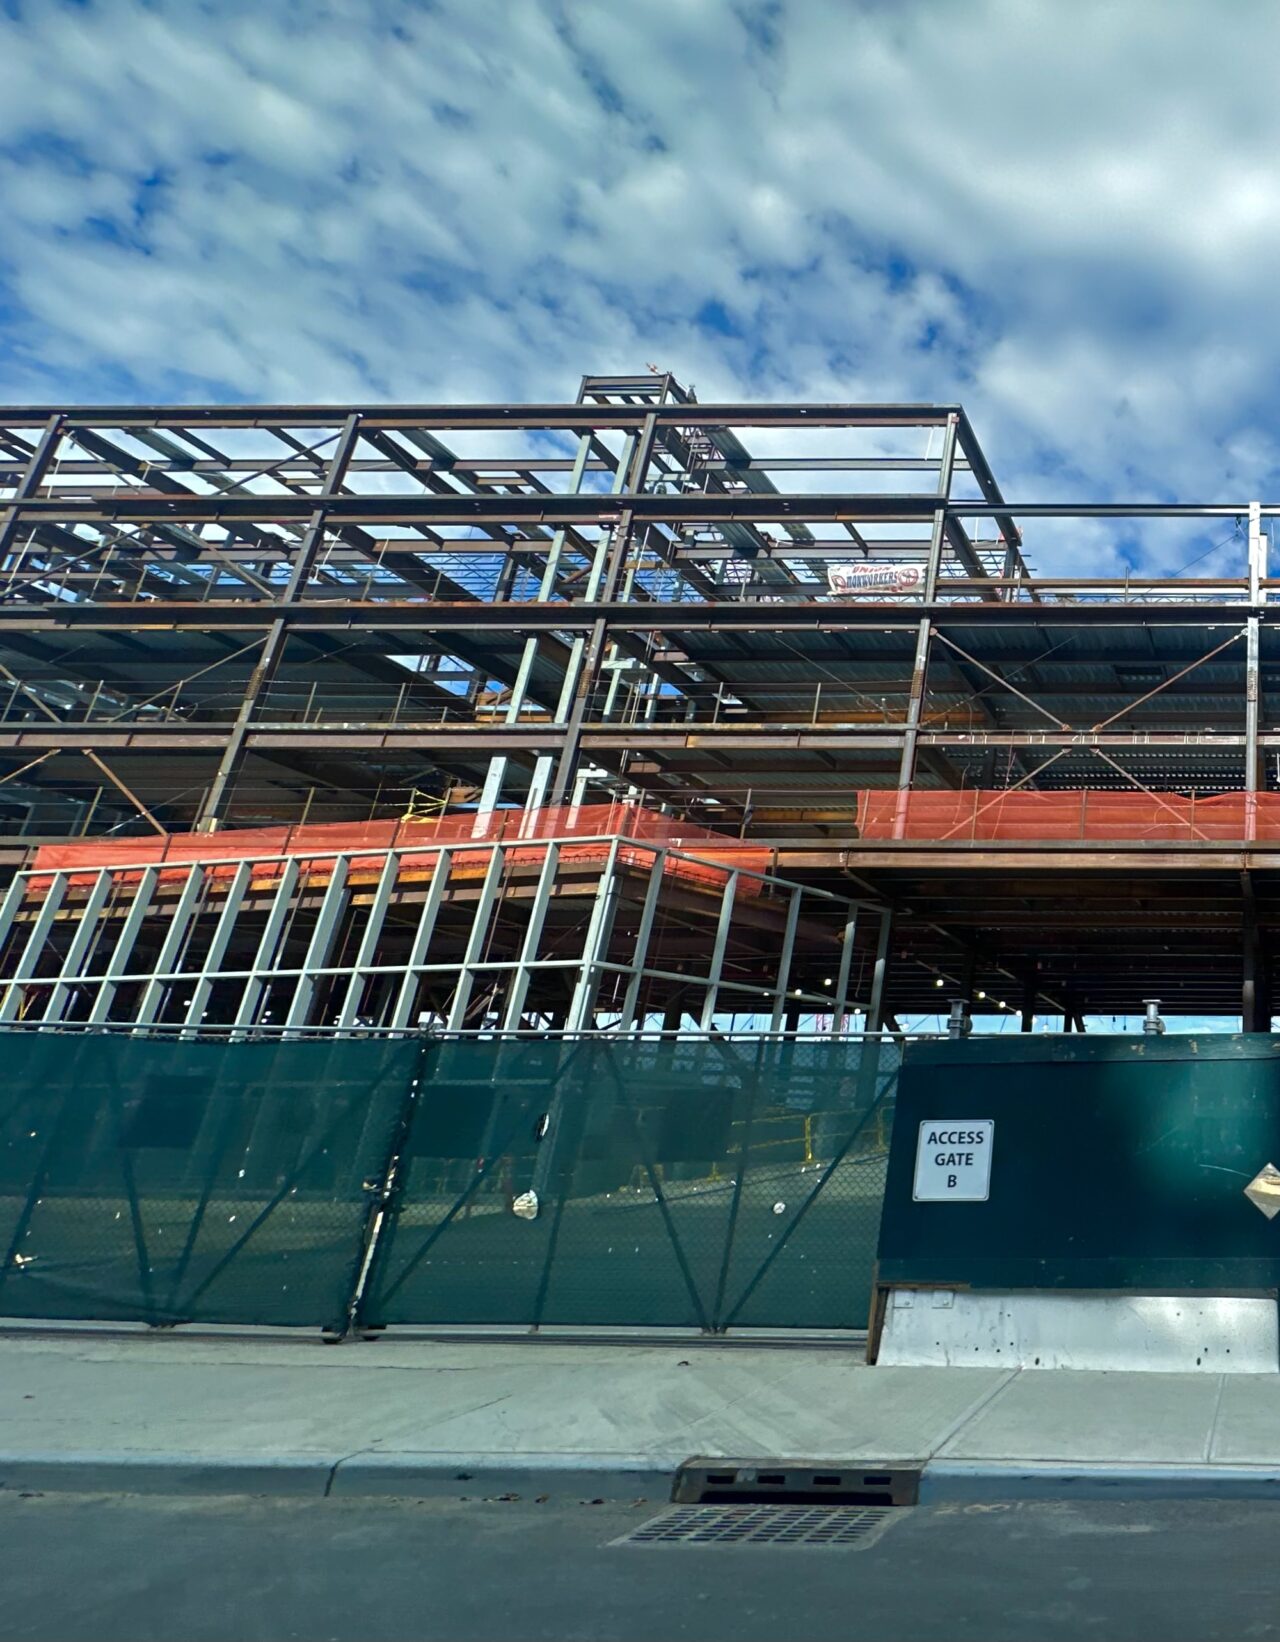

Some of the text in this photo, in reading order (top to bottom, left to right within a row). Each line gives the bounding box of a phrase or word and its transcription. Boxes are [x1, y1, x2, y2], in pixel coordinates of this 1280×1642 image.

[927, 1131, 984, 1144] ACCESS
[934, 1152, 974, 1166] GATE
[947, 1174, 957, 1188] B
